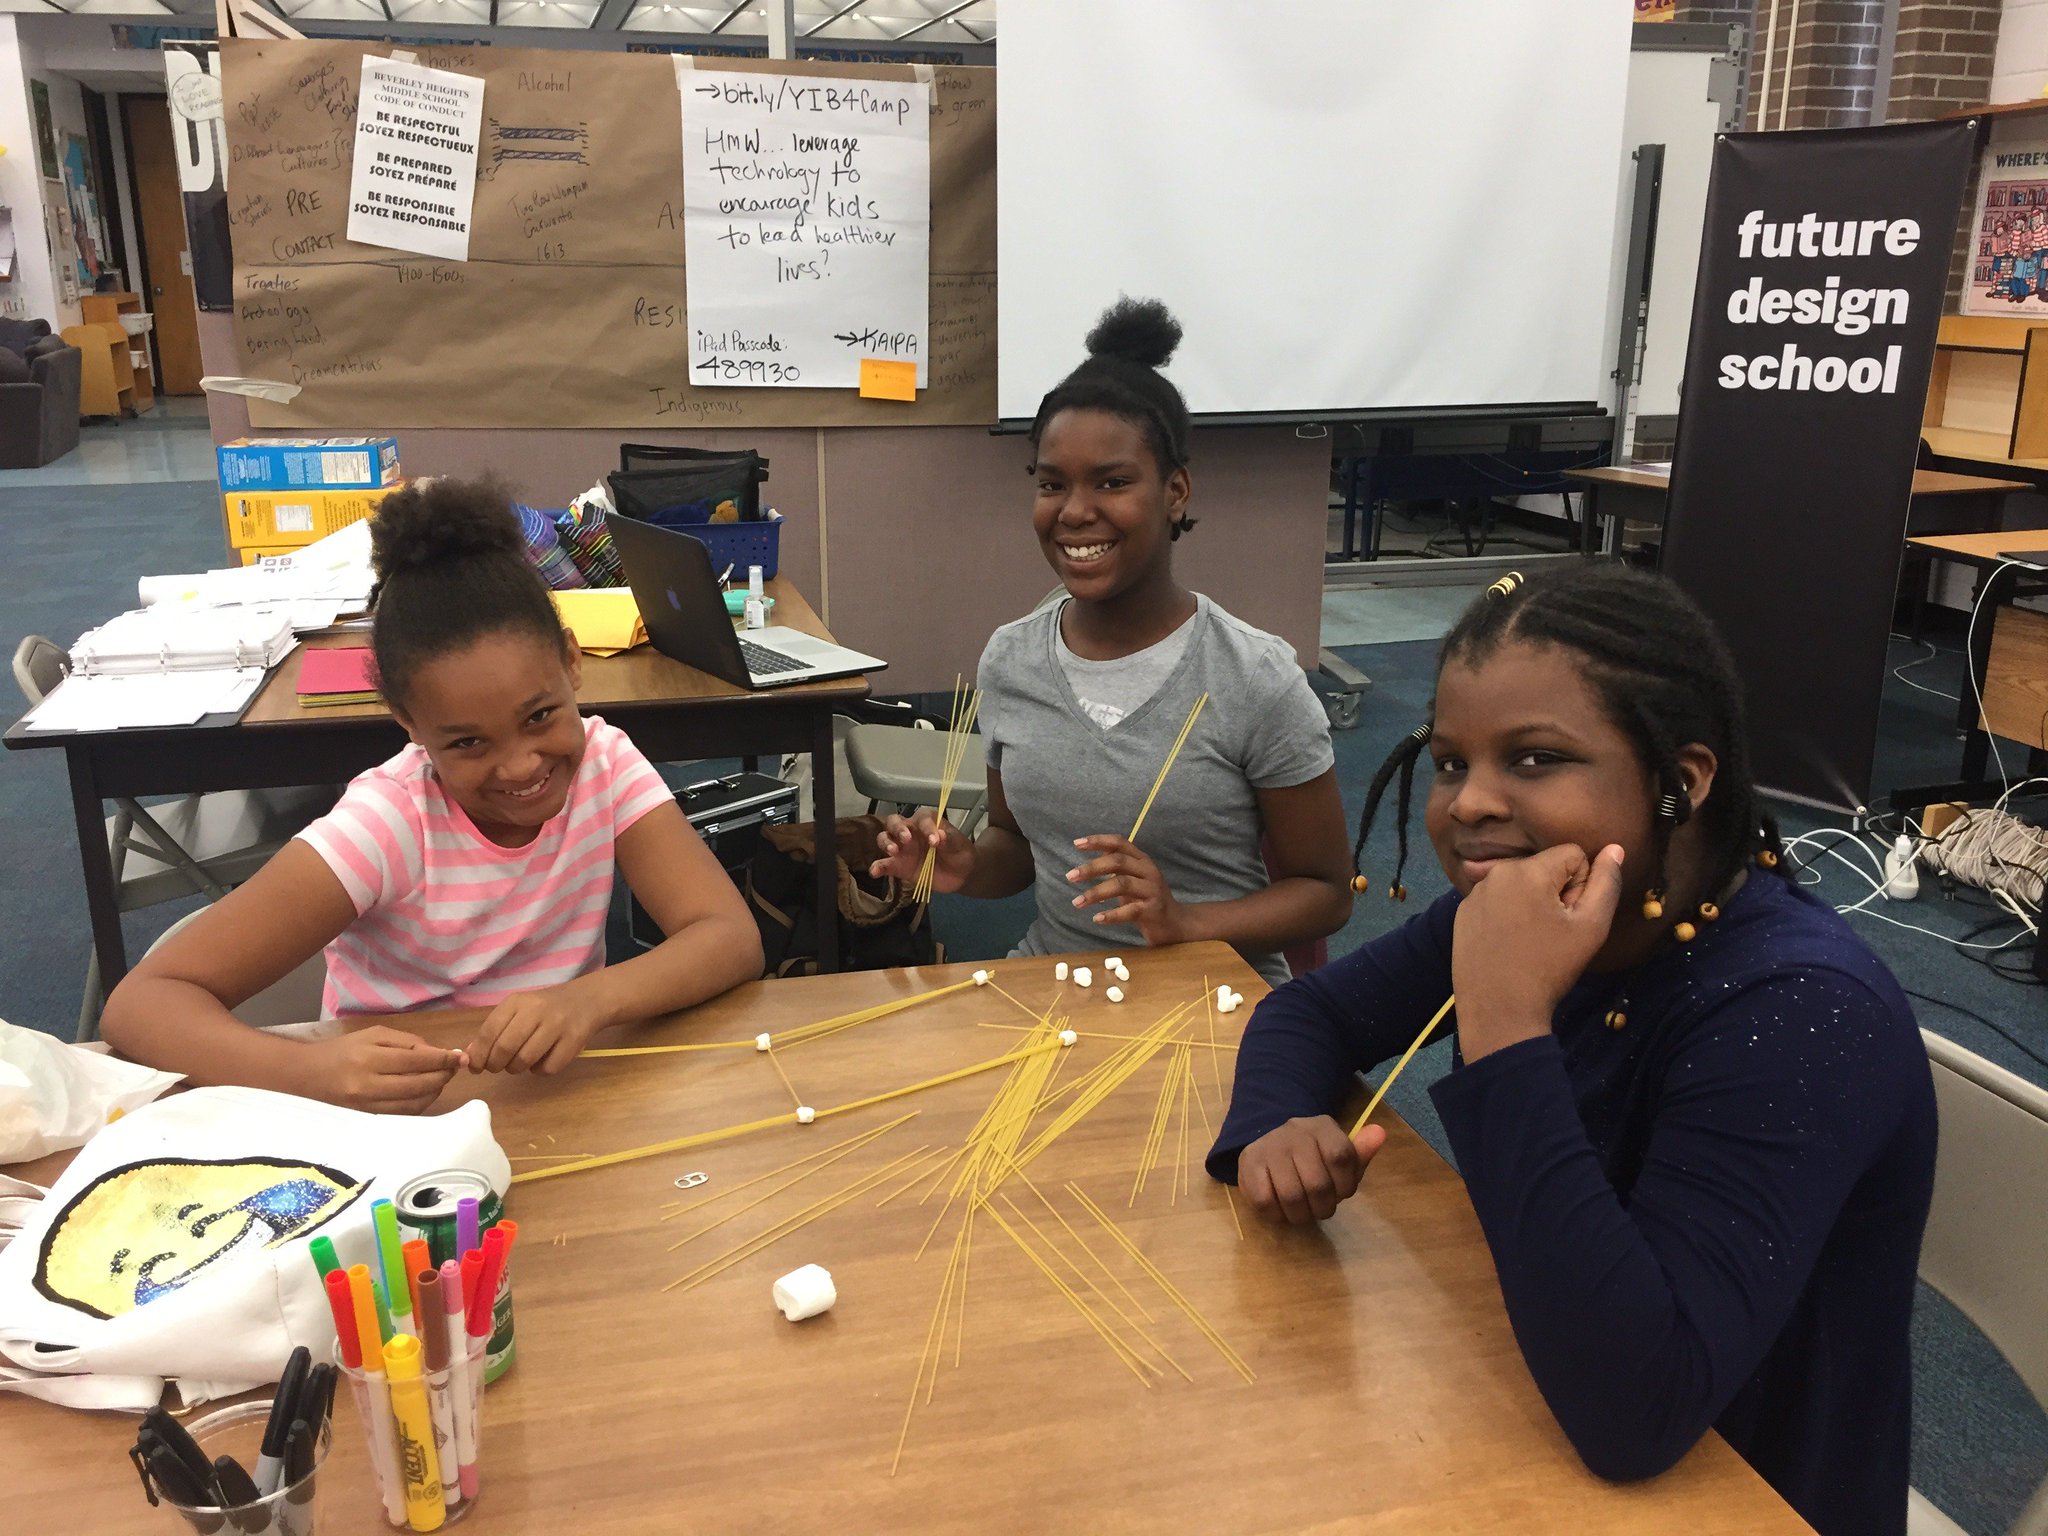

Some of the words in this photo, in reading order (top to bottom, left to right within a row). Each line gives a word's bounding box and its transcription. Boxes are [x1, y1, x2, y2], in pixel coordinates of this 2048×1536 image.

[428, 49, 474, 68] horses
[181, 88, 208, 102] LOVE
[374, 71, 425, 89] BEVERLEY
[426, 82, 469, 98] HEIGHTS
[381, 84, 420, 98] MIDDLE
[422, 93, 460, 107] SCHOOL
[518, 71, 572, 92] Alcohol
[374, 94, 400, 105] CODE
[403, 99, 416, 108] OF
[418, 102, 466, 118] CONDUCT
[360, 122, 395, 138] SOYEZ
[397, 129, 474, 154] RESPECTUEUX
[376, 111, 390, 123] BE
[393, 114, 460, 137] RESPECTFUL
[377, 152, 391, 163] BE
[393, 155, 452, 175] PREPARED
[793, 133, 860, 167] leverage
[369, 165, 404, 181] SOYEZ
[407, 173, 457, 191] PRÉPARÉ
[710, 157, 821, 203] technology
[832, 160, 861, 187] to
[286, 188, 323, 217] PRE
[368, 191, 382, 202] BE
[385, 194, 455, 217] RESPONSIBLE
[719, 198, 811, 227] encourage
[827, 192, 879, 220] kids
[354, 203, 389, 218] SOYEZ
[392, 210, 466, 233] RESPONSABLE
[272, 232, 336, 262] CONTACT
[717, 224, 751, 249] to
[758, 222, 803, 244] lead
[815, 223, 896, 246] healthier
[1738, 209, 1921, 259] future
[537, 242, 565, 263] 1613
[777, 249, 831, 283] lives?
[244, 273, 300, 292] Treaties
[633, 296, 688, 328] RESI
[1726, 275, 1910, 336] design
[697, 330, 728, 352] iPad
[860, 327, 918, 355] KAIPA
[696, 355, 801, 384] 489930
[1718, 343, 1902, 395] school
[650, 387, 743, 422] Indigenous
